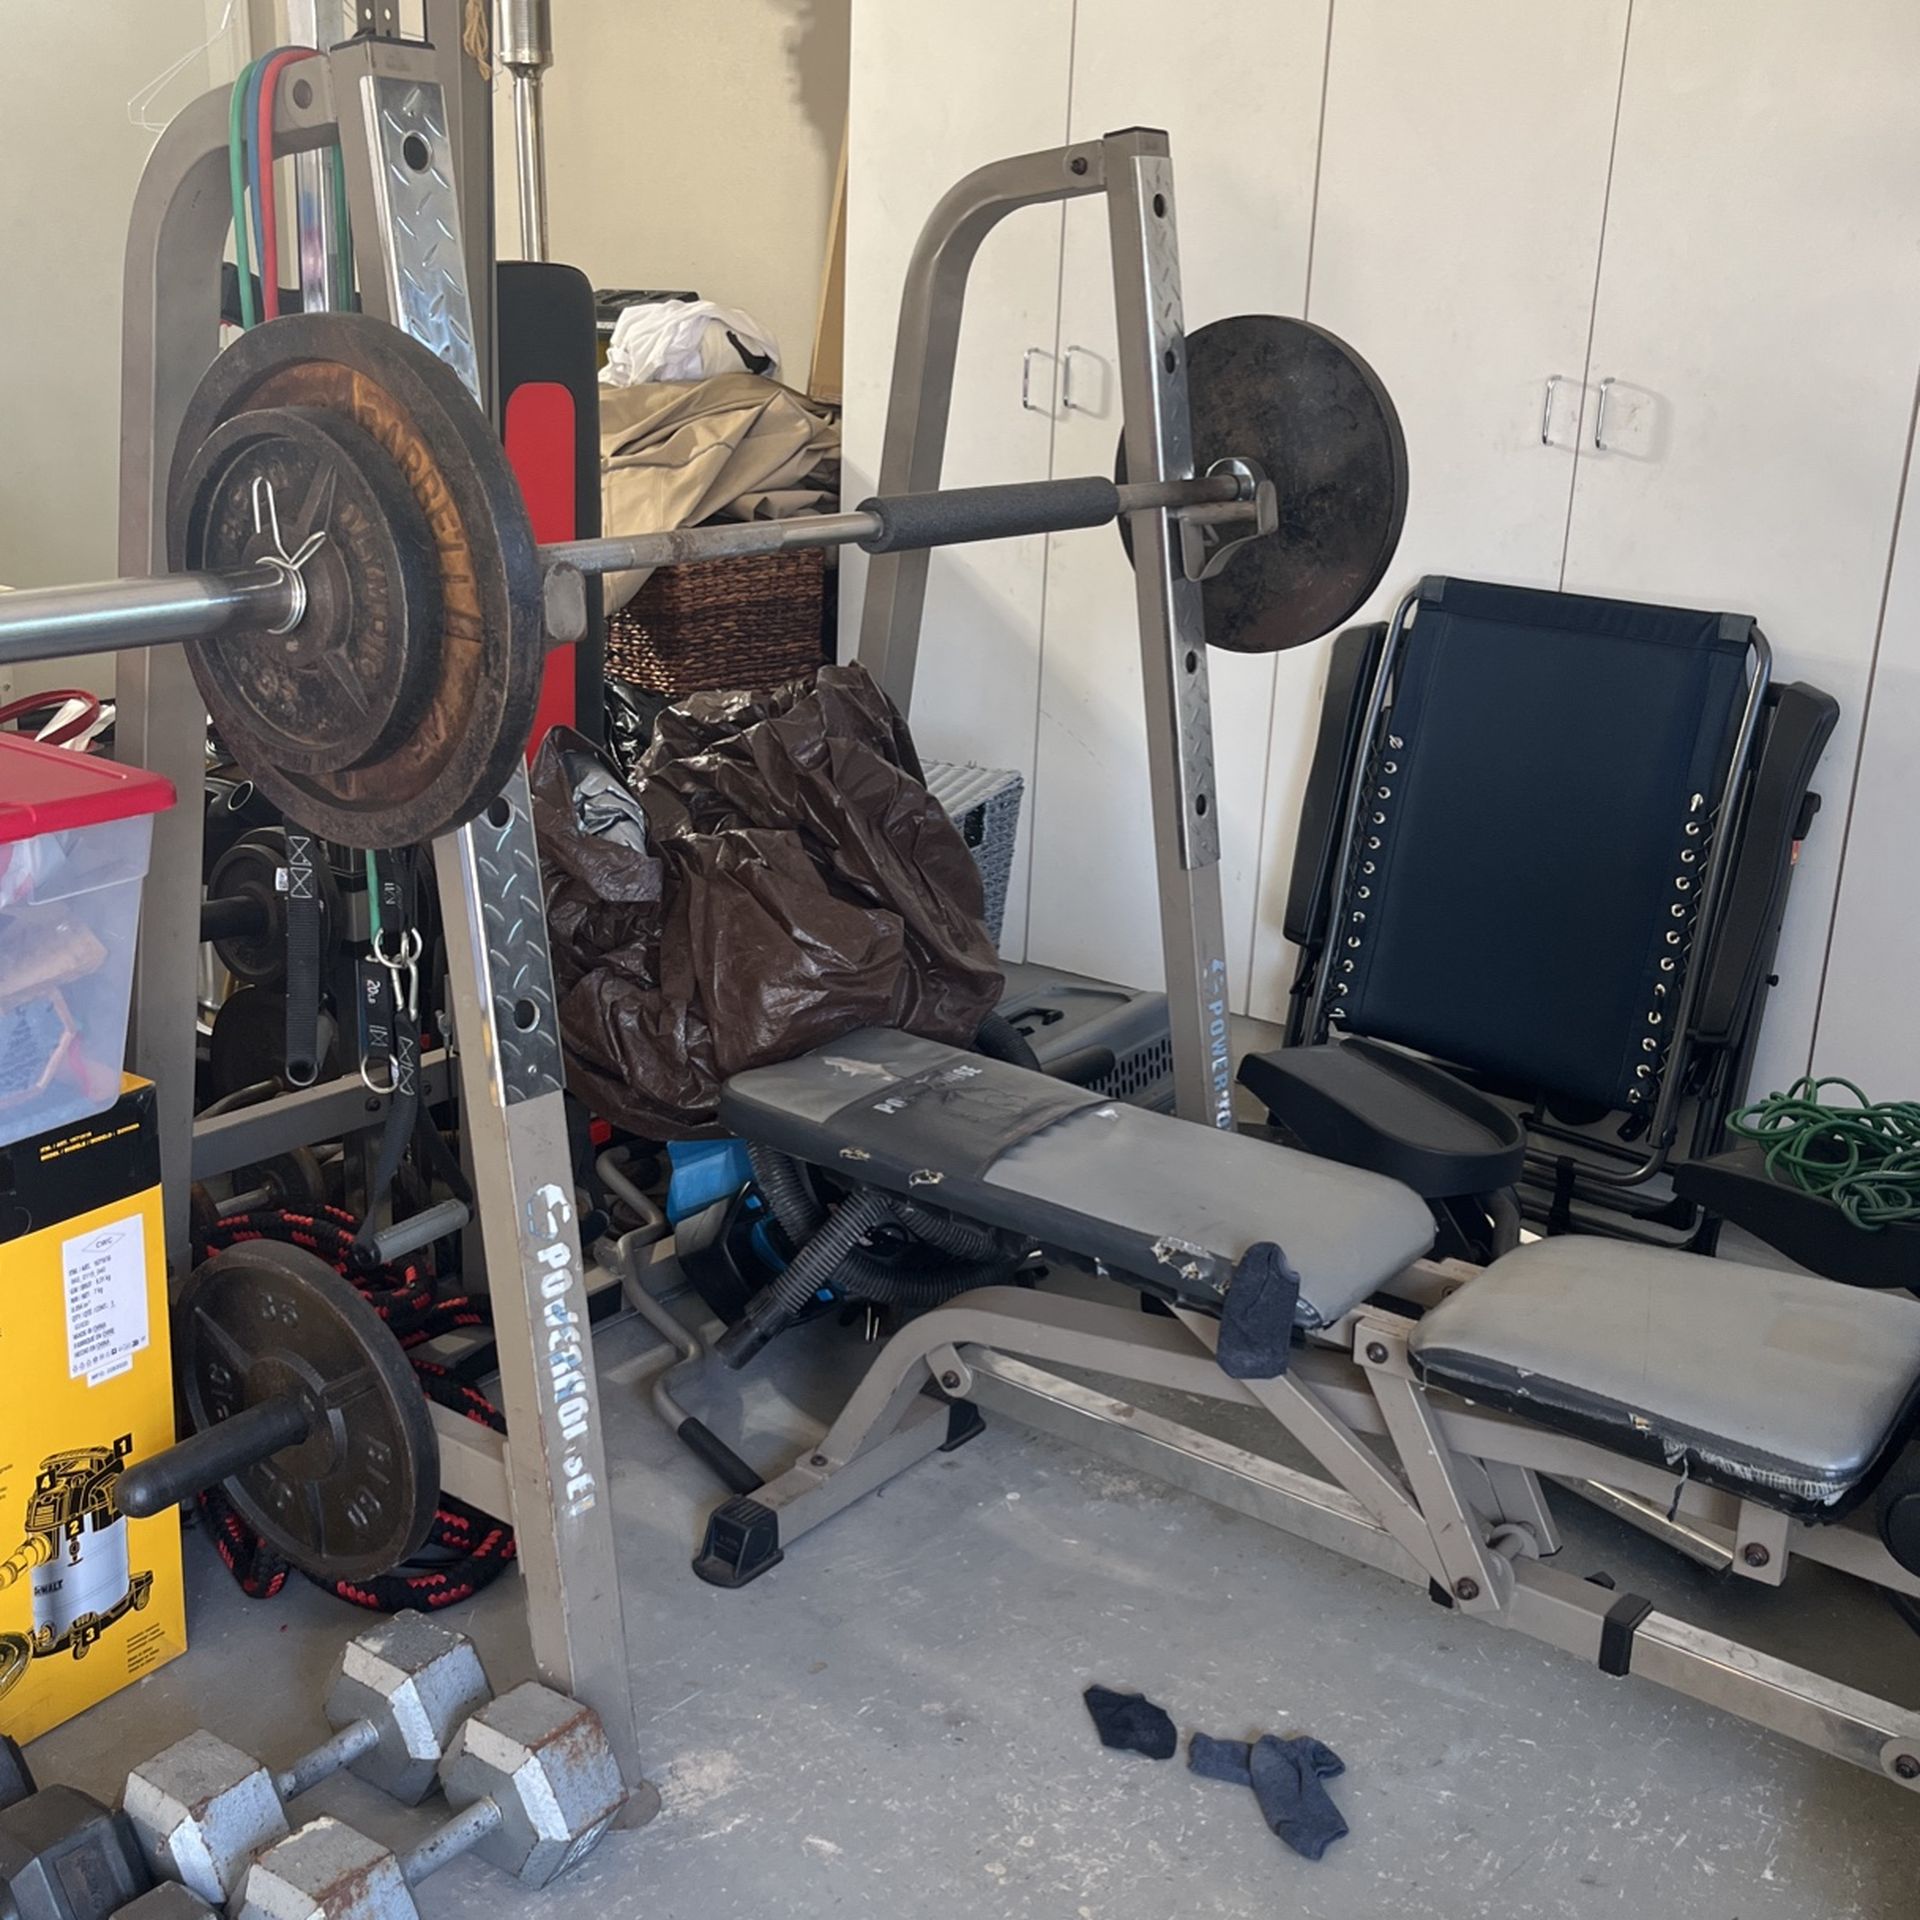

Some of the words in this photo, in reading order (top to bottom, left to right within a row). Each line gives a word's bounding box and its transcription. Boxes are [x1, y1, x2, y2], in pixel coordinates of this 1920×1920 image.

[119, 1439, 127, 1454] 1
[40, 1474, 51, 1491] 4
[69, 1520, 80, 1535] 2
[86, 1626, 95, 1641] 3
